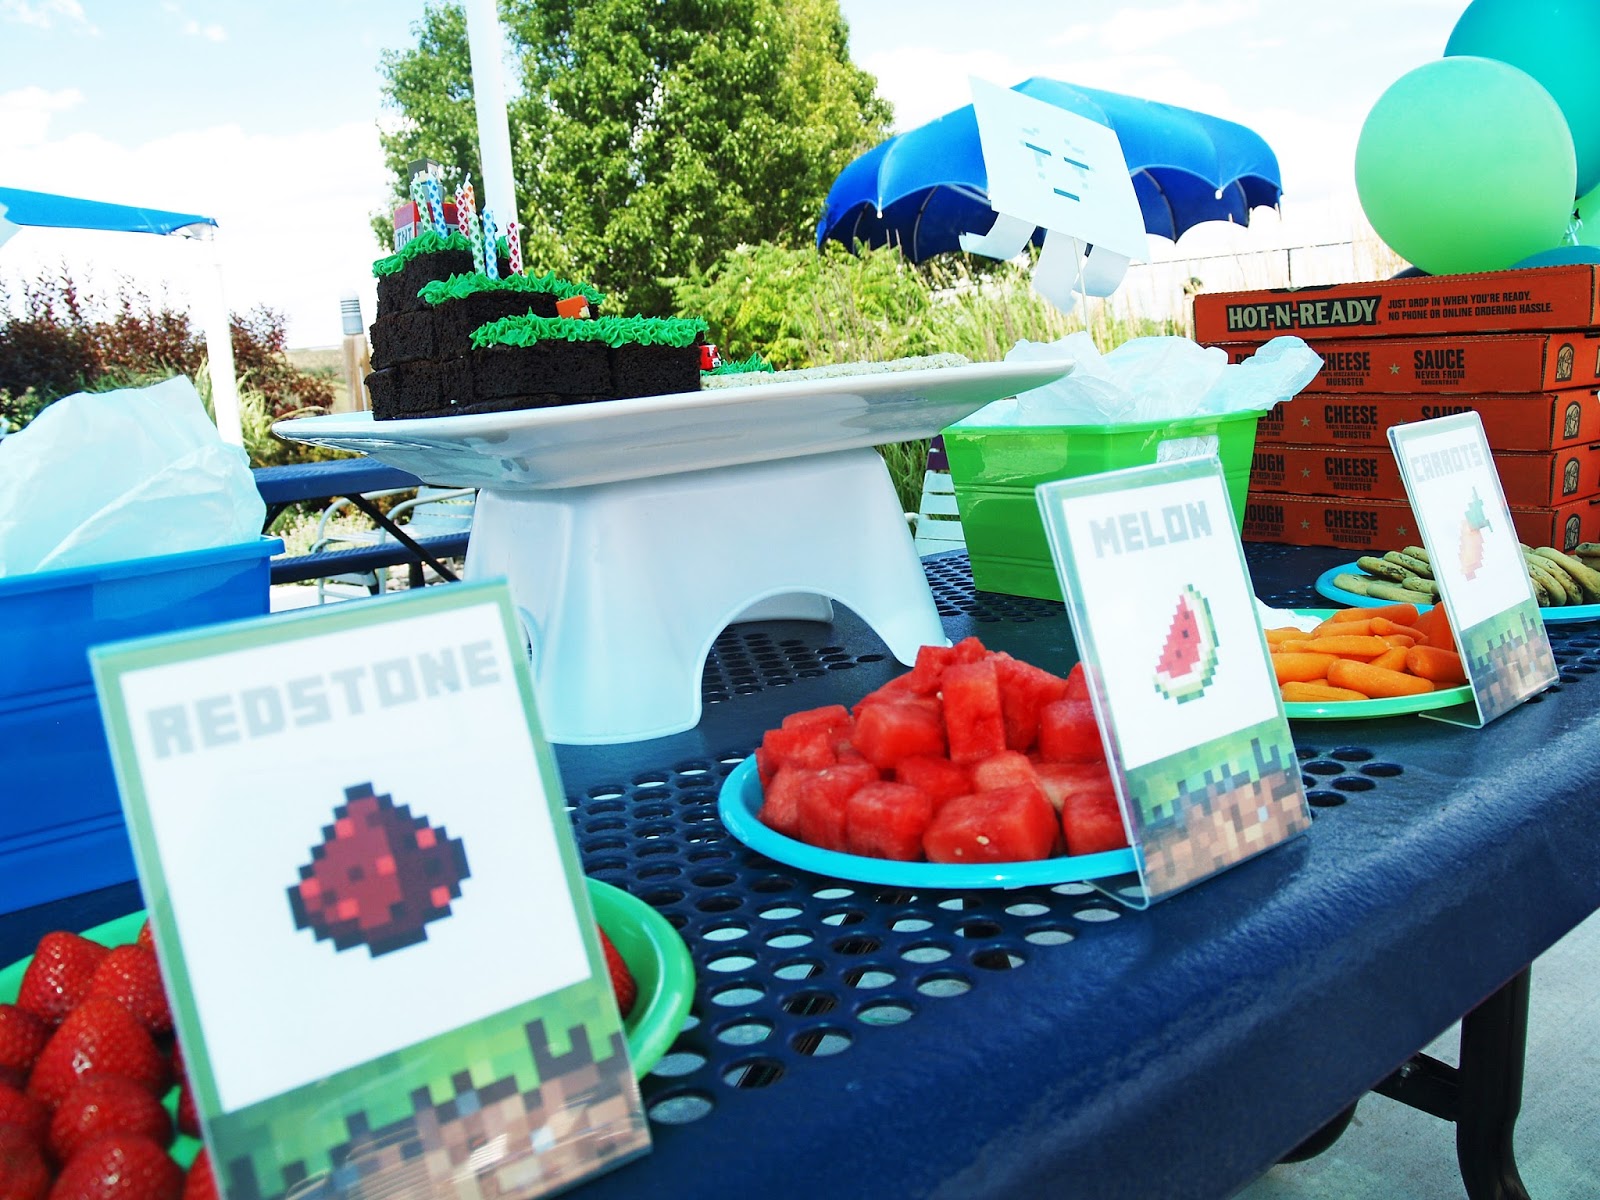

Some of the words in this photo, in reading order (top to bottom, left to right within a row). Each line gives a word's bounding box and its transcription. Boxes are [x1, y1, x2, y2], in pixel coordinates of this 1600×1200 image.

[1388, 299, 1406, 309] JUST
[1409, 298, 1430, 308] DROP
[1432, 297, 1441, 306] IN
[1443, 295, 1468, 306] WHEN
[1471, 293, 1500, 304] YOU'RE
[1502, 291, 1532, 302] READY.
[1228, 299, 1377, 329] HOT-N-READY
[1388, 311, 1400, 321] NO
[1402, 310, 1428, 320] PHONE
[1430, 309, 1441, 319] OR
[1443, 307, 1473, 318] ONLINE
[1475, 304, 1517, 317] ORDERING
[1519, 303, 1554, 314] HASSLE.
[1414, 349, 1465, 370] SAUCE
[1326, 377, 1364, 386] MUENSTER
[1415, 370, 1440, 379] NEVER
[1442, 370, 1465, 379] FROM
[1324, 404, 1378, 425] CHEESE
[1332, 430, 1372, 439] MUENSTER
[1251, 452, 1285, 473] OUGH
[1324, 456, 1379, 478] CHEESE
[1410, 441, 1483, 483] CARROTS
[1246, 504, 1284, 523] OUGH
[1324, 509, 1378, 530] CHEESE
[1088, 500, 1213, 559] MELON
[146, 638, 501, 760] REDSTONE
